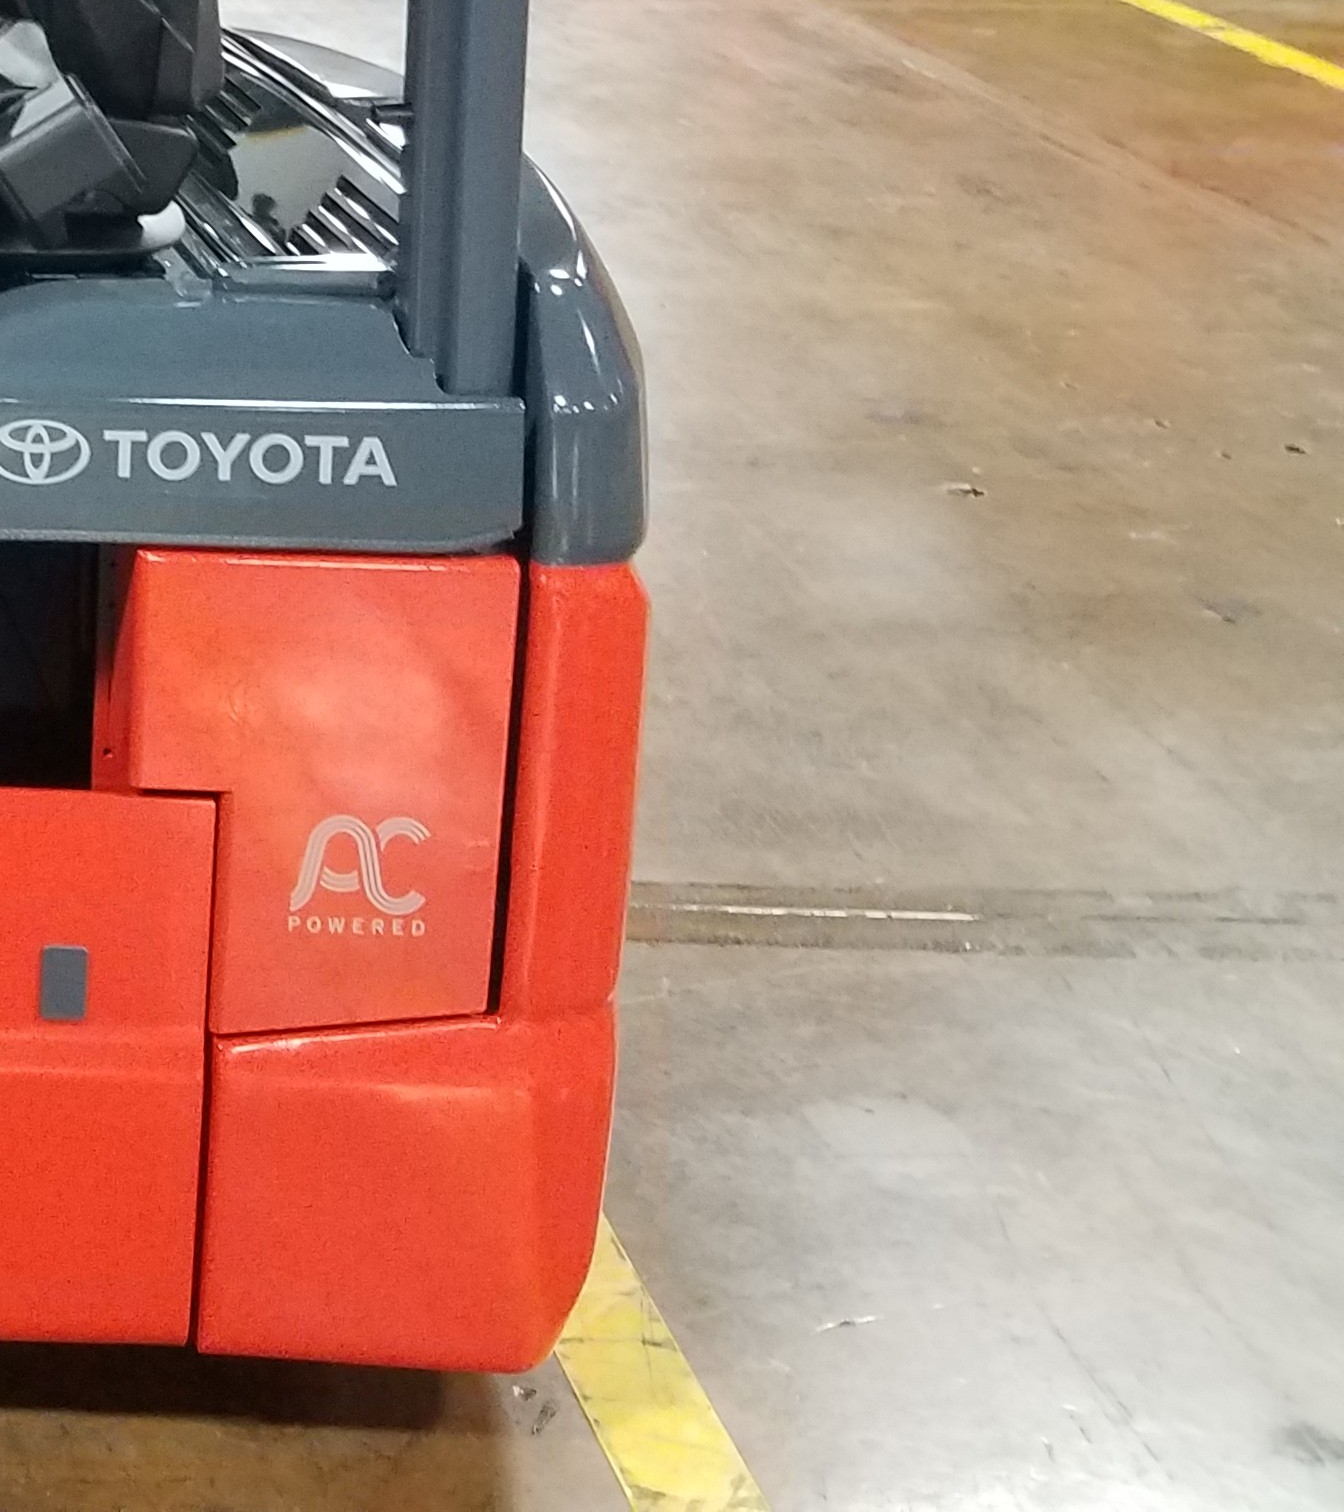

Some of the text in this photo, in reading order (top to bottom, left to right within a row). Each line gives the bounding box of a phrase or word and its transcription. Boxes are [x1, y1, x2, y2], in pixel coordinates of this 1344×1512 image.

[103, 429, 398, 487] TOYOTA
[289, 815, 430, 916] AC
[288, 916, 427, 938] POWERED
